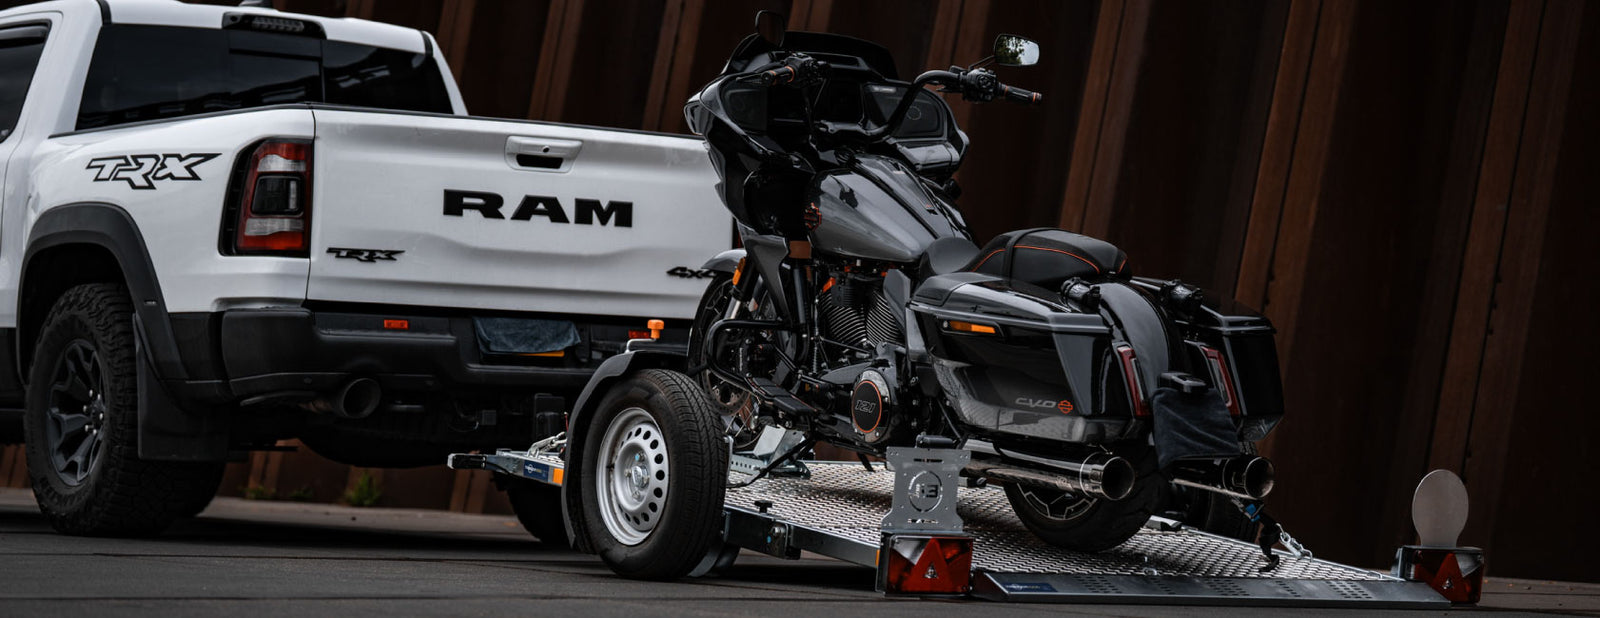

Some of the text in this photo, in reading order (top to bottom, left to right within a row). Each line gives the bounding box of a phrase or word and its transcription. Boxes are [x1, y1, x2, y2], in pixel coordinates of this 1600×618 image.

[86, 153, 222, 190] TRX
[443, 189, 633, 228] RAM
[326, 247, 405, 263] TRX
[855, 399, 876, 413] 121
[1015, 397, 1057, 408] CVO
